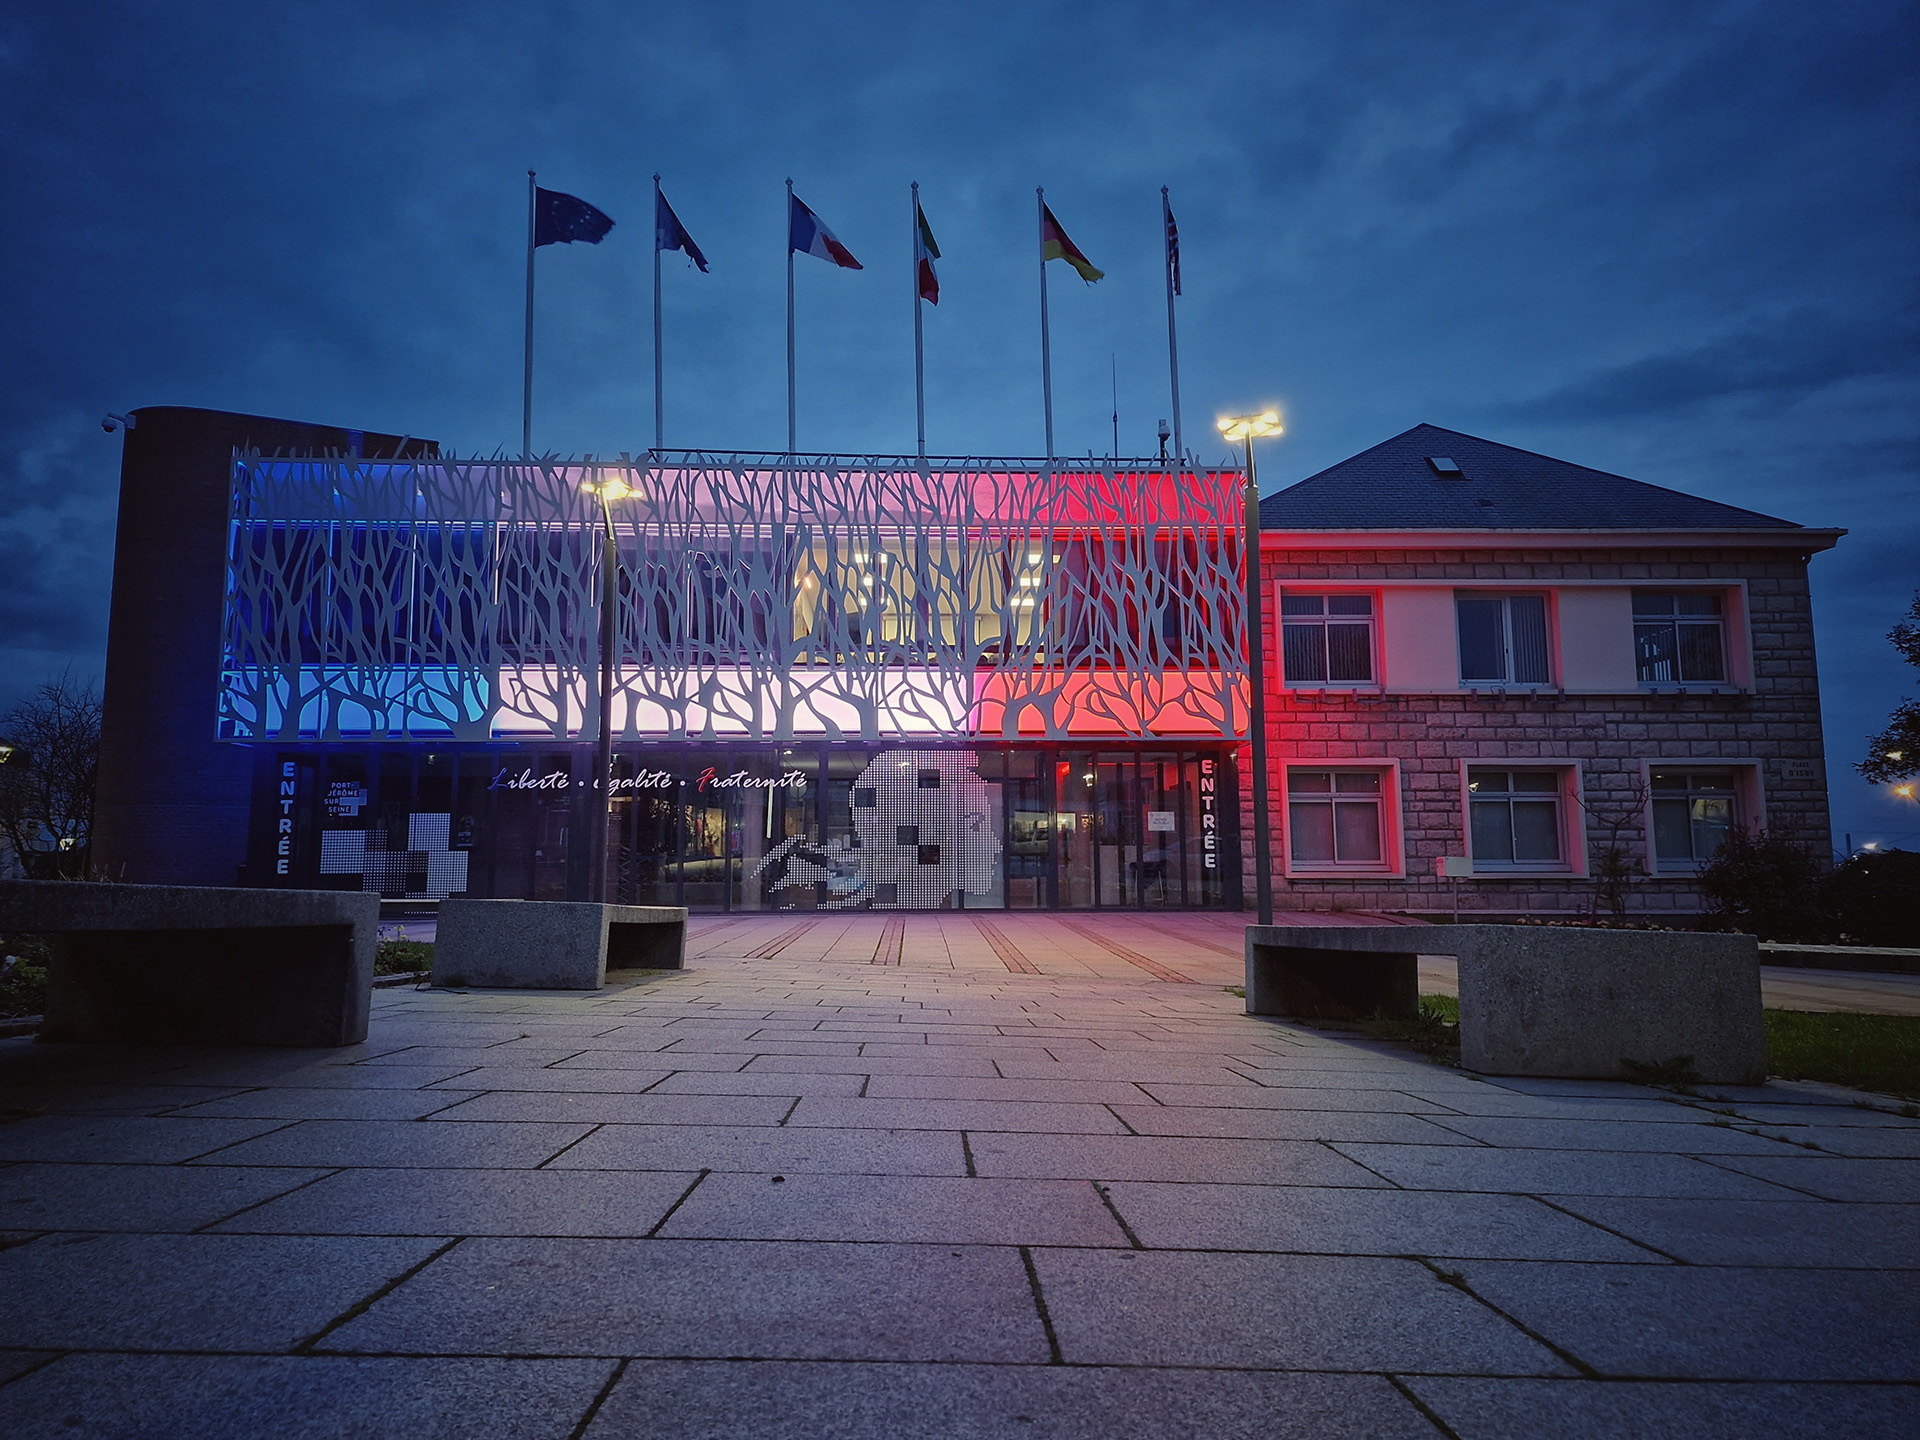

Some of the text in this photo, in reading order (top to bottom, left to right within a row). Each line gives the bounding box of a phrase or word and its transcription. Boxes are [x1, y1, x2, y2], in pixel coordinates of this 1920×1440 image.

[276, 761, 296, 875] ENTRÉE
[486, 767, 570, 791] Liberté
[696, 766, 808, 793] Fraternité
[1200, 759, 1217, 869] ENTRÉE
